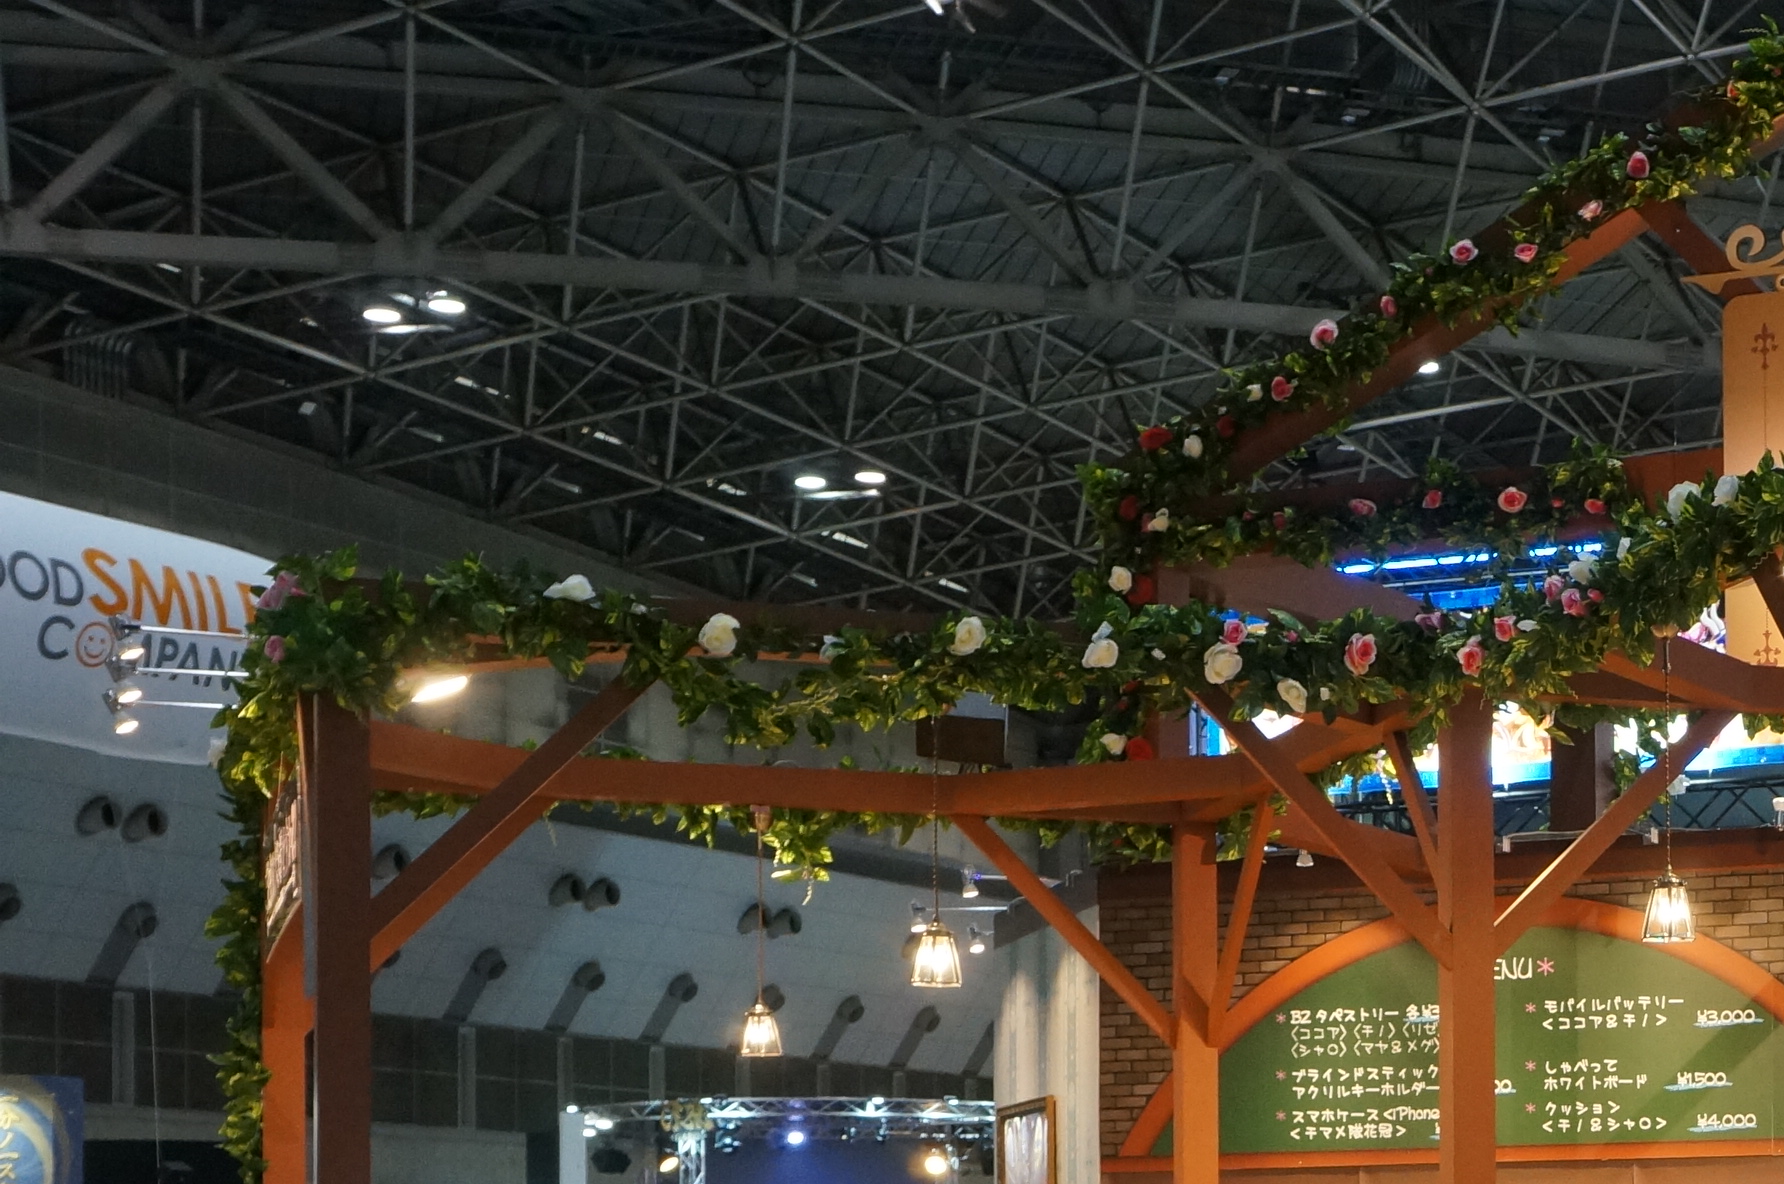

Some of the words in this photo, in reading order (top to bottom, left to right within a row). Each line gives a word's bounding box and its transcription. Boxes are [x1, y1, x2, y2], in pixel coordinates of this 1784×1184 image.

[1544, 996, 1684, 1013] モバイルバッテリー
[1290, 1009, 1311, 1024] B2
[1316, 1008, 1399, 1024] タペストリー
[1697, 1008, 1756, 1025] ¥3,000
[1545, 1059, 1618, 1074] しゃべって
[1544, 1073, 1647, 1091] ホワイトボード
[1677, 1071, 1727, 1086] ¥1,500
[1292, 1108, 1379, 1123] スマホケース
[1545, 1100, 1620, 1116] クッション
[1697, 1113, 1757, 1128] ¥4,000
